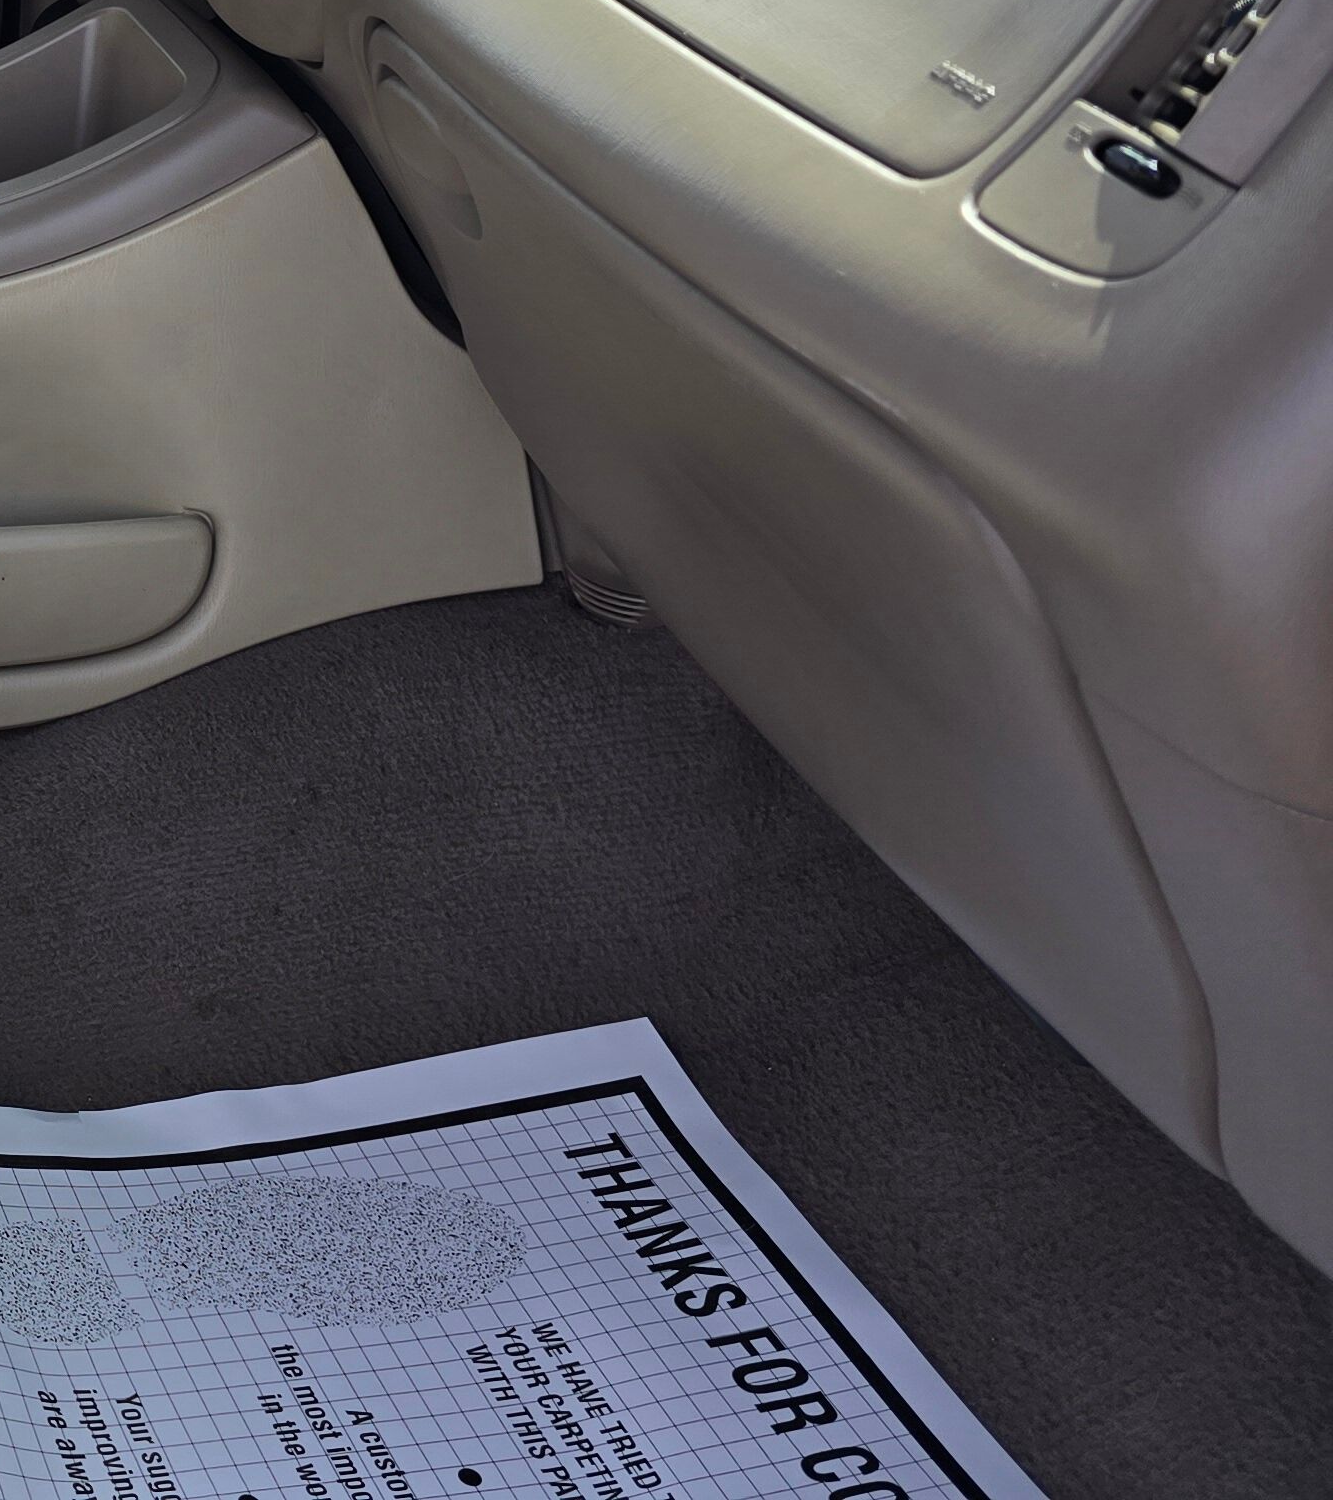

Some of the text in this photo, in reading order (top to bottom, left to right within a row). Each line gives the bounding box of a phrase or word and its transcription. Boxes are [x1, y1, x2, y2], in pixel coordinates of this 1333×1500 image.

[563, 1132, 747, 1317] THANKS
[705, 1327, 838, 1435] FOR
[271, 1344, 303, 1378] the
[293, 1385, 343, 1440] most
[495, 1326, 550, 1388] YOUR
[531, 1322, 662, 1489] WE HAVE TRIED
[37, 1390, 97, 1500] are alwa
[116, 1392, 154, 1444] Your
[257, 1394, 331, 1500] in the wo
[345, 1409, 375, 1426] A
[466, 1344, 586, 1500] WITH THIS PA
